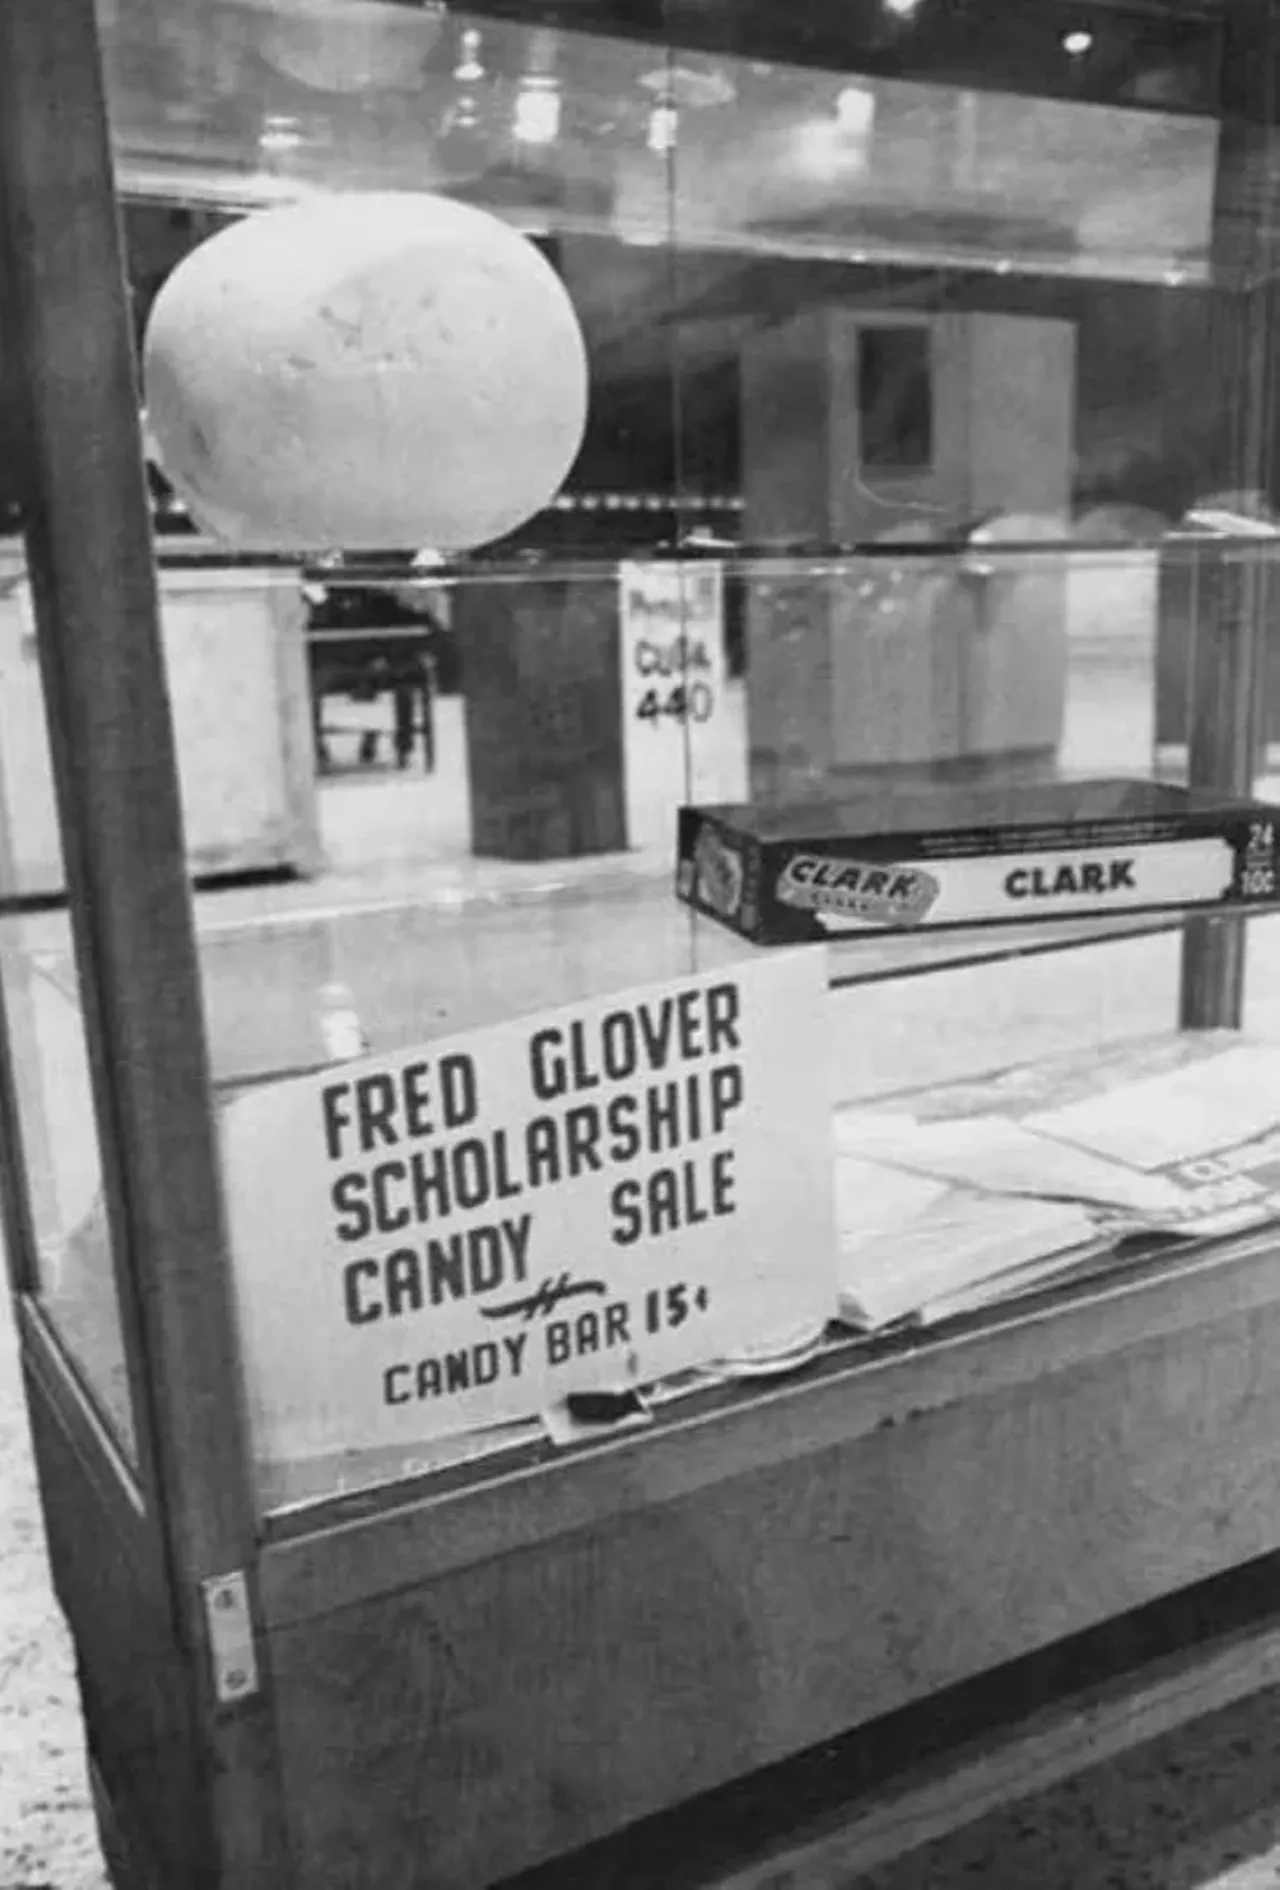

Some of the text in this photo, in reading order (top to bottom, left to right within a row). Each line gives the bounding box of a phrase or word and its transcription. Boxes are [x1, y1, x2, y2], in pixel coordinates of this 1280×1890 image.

[636, 680, 713, 730] 440
[790, 859, 916, 898] CLARK
[1004, 858, 1137, 899] CLARK
[322, 982, 741, 1161] FRED GLOVER
[331, 1064, 743, 1243] SCHOLARSHIP
[343, 1150, 737, 1326] CANDY SALE
[382, 1332, 528, 1406] CANDY
[545, 1301, 632, 1367] BAR
